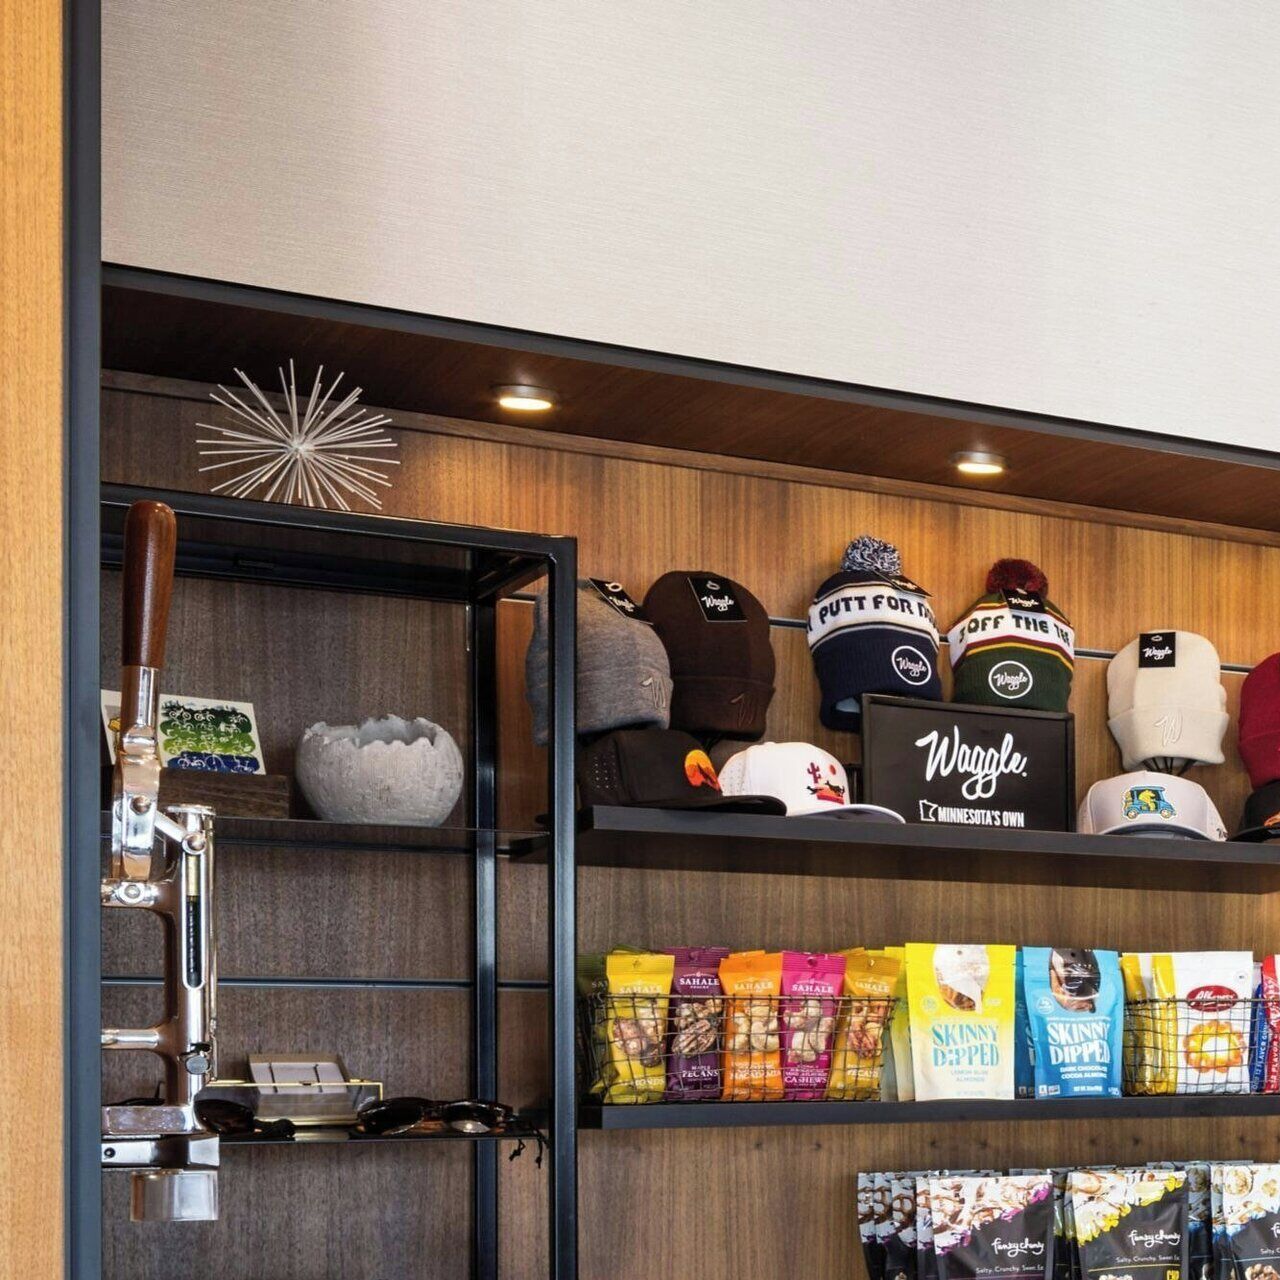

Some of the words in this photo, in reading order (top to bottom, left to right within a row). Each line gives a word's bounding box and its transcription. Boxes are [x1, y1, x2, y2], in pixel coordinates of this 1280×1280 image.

[819, 596, 867, 625] PUTT
[873, 594, 914, 616] FOR
[967, 614, 1005, 634] OFF
[1012, 614, 1049, 634] THE
[938, 805, 1000, 828] MINNESOTA'S
[1002, 810, 1025, 829] OWN
[679, 977, 720, 988] SAHALE
[791, 984, 834, 994] SAHALE
[930, 1022, 999, 1047] SKINNY
[1046, 1019, 1111, 1047] SKINNY
[932, 1044, 1000, 1068] DIPPED
[1049, 1040, 1112, 1065] DIPPED
